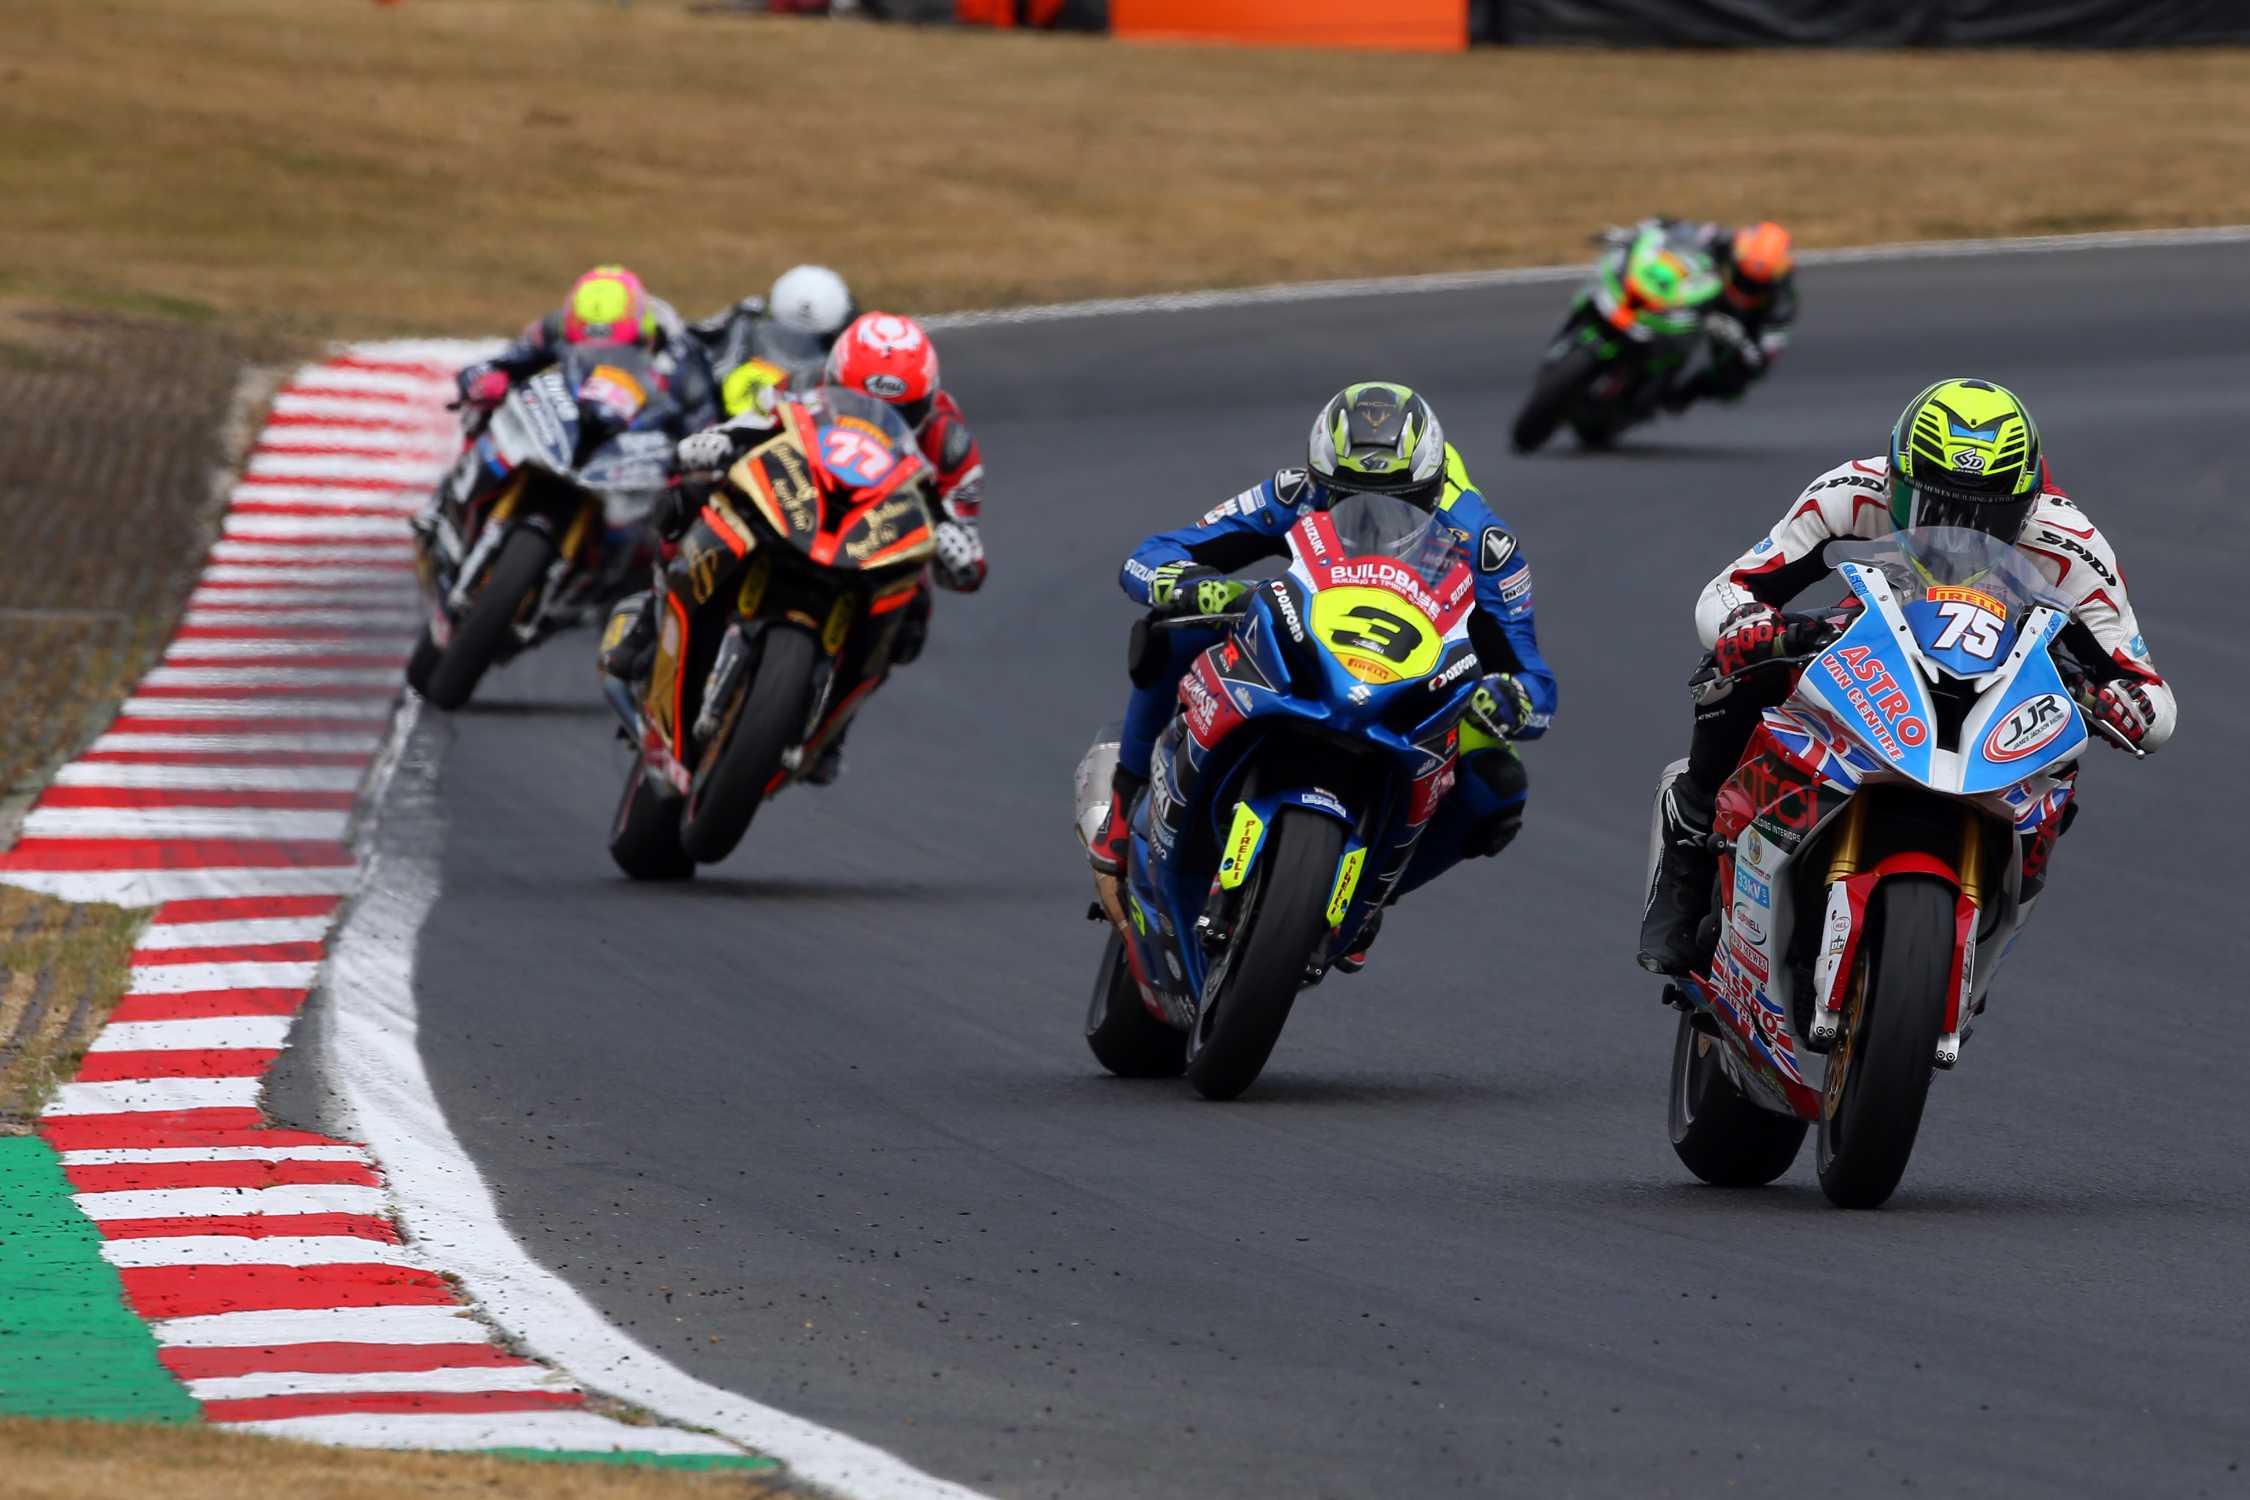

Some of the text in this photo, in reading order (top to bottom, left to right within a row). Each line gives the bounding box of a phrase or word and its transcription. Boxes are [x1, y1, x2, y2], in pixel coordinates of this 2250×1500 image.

[824, 429, 895, 480] 77
[1301, 517, 1326, 556] SUZUKI
[2036, 530, 2117, 586] SPIDI
[1330, 563, 1440, 619] BUILDBASE
[1450, 573, 1473, 606] SUZUKI
[1277, 595, 1305, 643] OXFORD
[1331, 606, 1423, 663] 3
[1932, 601, 2007, 660] 75
[1348, 658, 1389, 680] PIRELLI
[1446, 653, 1478, 681] OXFORD
[1821, 653, 1905, 761] VAN CENTRE
[1837, 646, 1928, 747] ASTRO
[2004, 695, 2061, 747] JJR
[1233, 820, 1256, 880] PIRELLI
